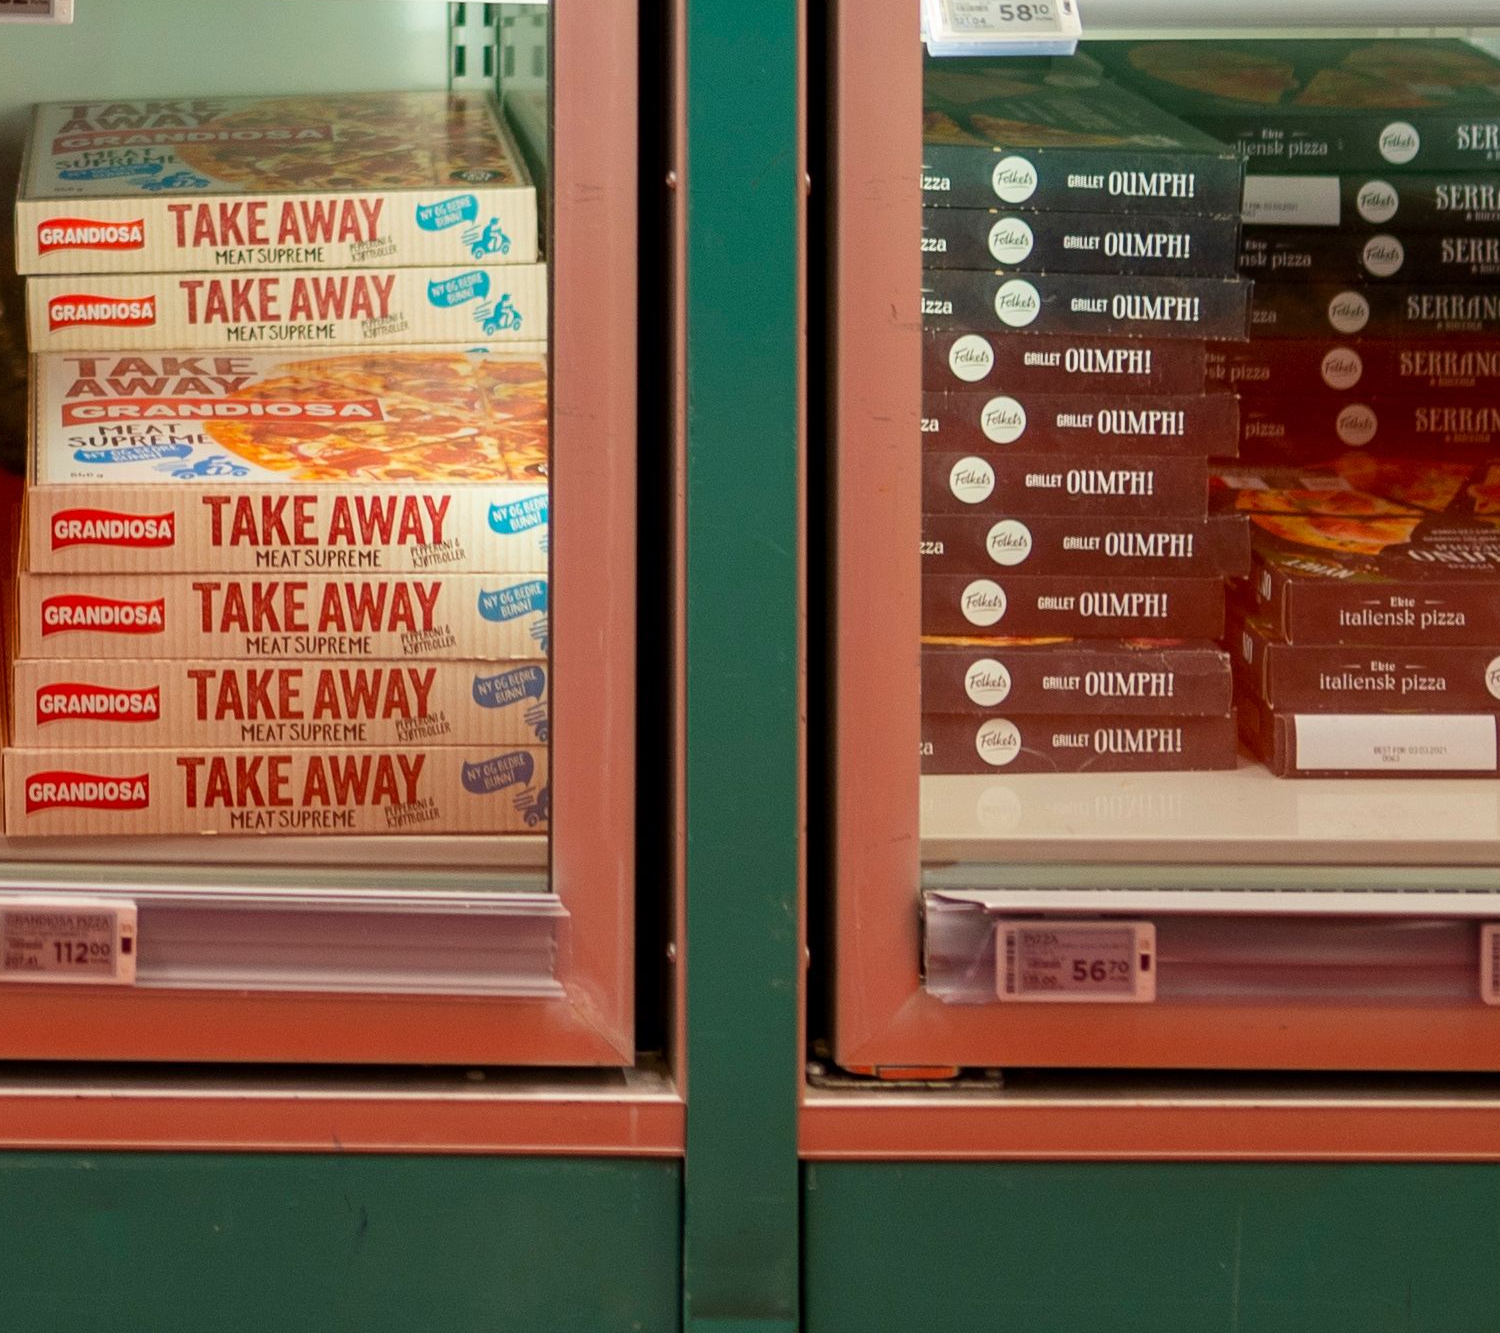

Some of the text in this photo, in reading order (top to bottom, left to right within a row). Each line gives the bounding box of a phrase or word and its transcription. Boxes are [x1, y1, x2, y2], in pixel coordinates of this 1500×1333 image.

[997, 170, 1196, 199] Folkets GRILLET OUMPH!
[55, 495, 452, 545] GRANDIOSA TAKE AWAY
[256, 550, 382, 567] MEAT SUPREME
